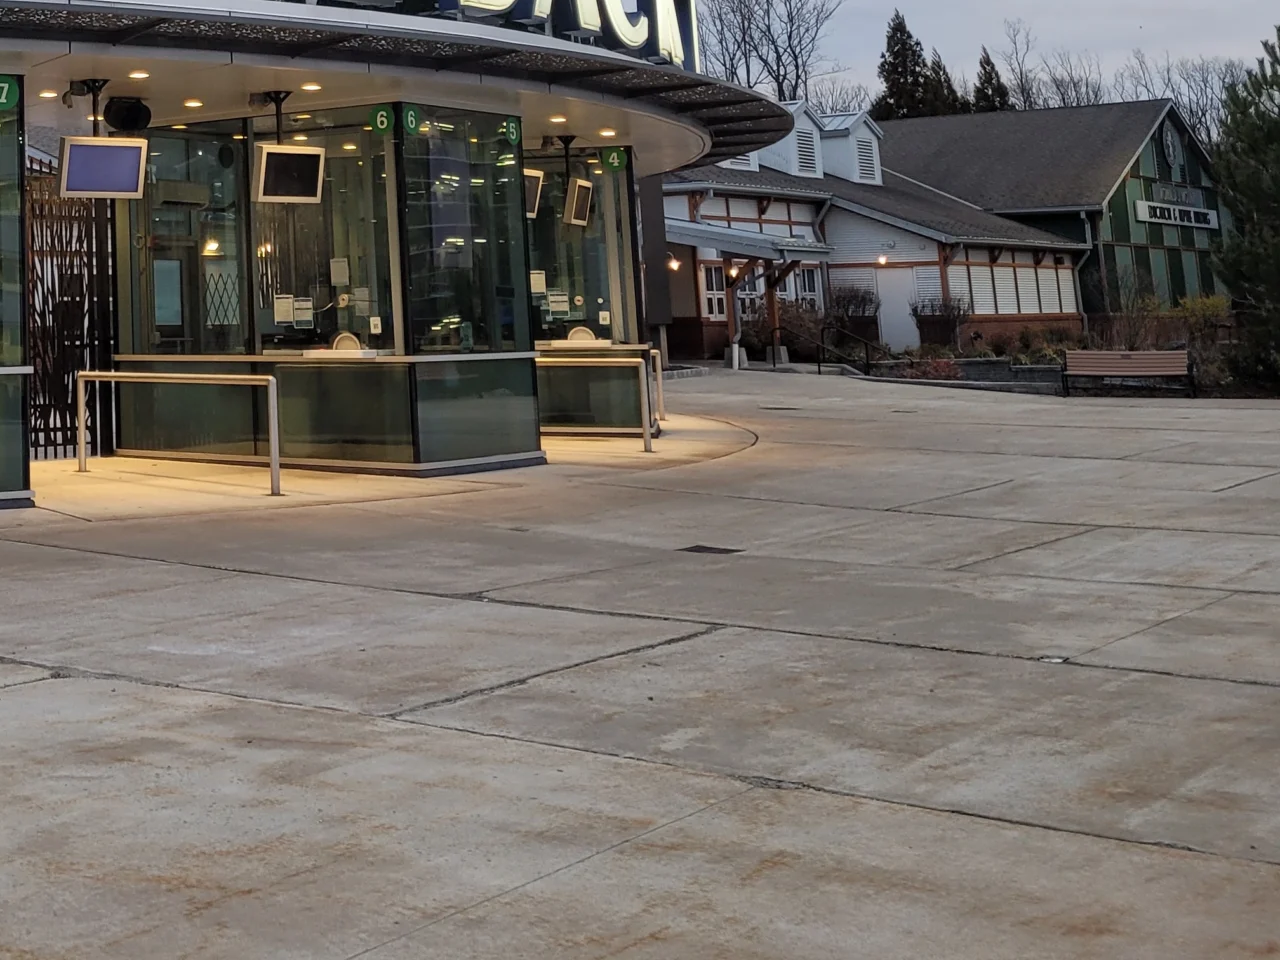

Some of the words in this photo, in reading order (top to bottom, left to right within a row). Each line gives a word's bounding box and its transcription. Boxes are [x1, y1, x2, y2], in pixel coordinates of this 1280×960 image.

[376, 110, 388, 129] 6
[407, 110, 416, 129] 6
[509, 122, 517, 143] 5
[608, 152, 620, 167] 4
